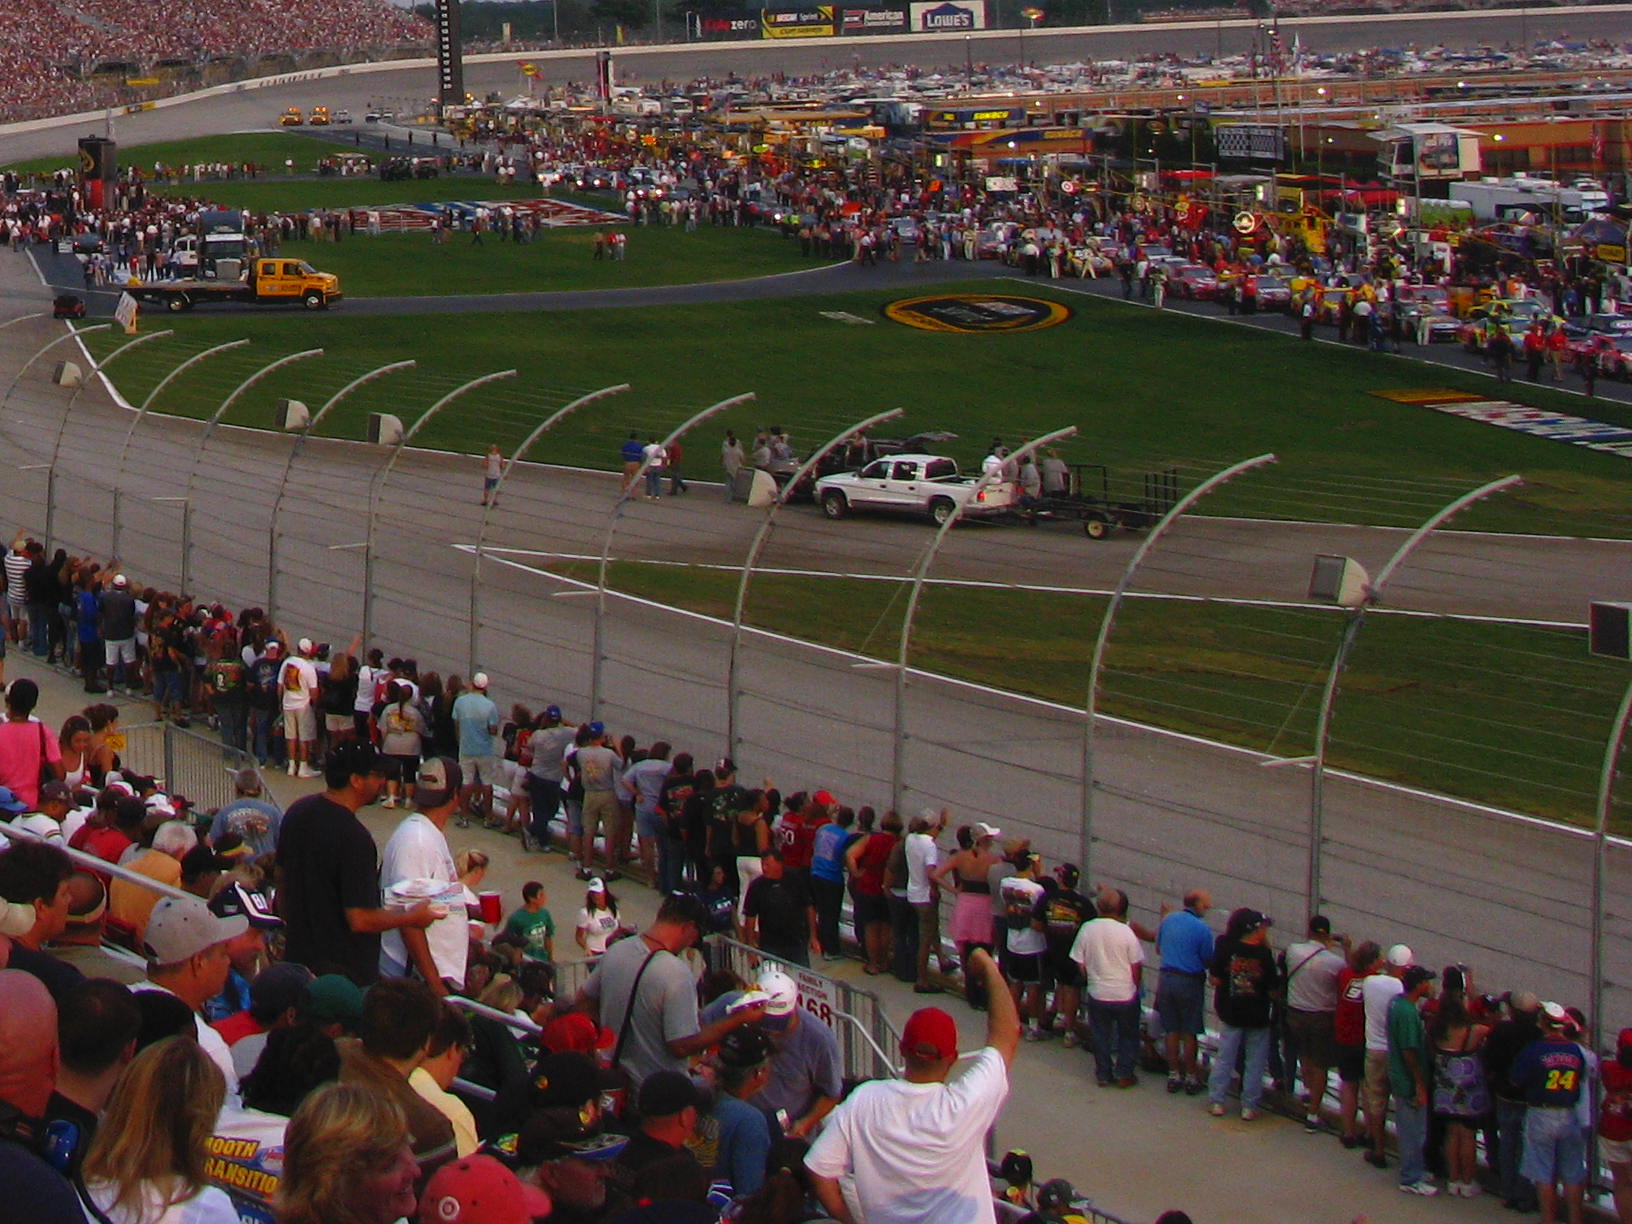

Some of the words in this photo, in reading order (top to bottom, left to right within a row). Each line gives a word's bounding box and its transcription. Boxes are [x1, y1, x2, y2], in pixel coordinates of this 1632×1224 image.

[730, 19, 757, 30] zero
[926, 13, 969, 27] LOWE'S
[799, 971, 824, 988] FAMILY
[796, 993, 833, 1028] 168
[1545, 1069, 1576, 1092] 24
